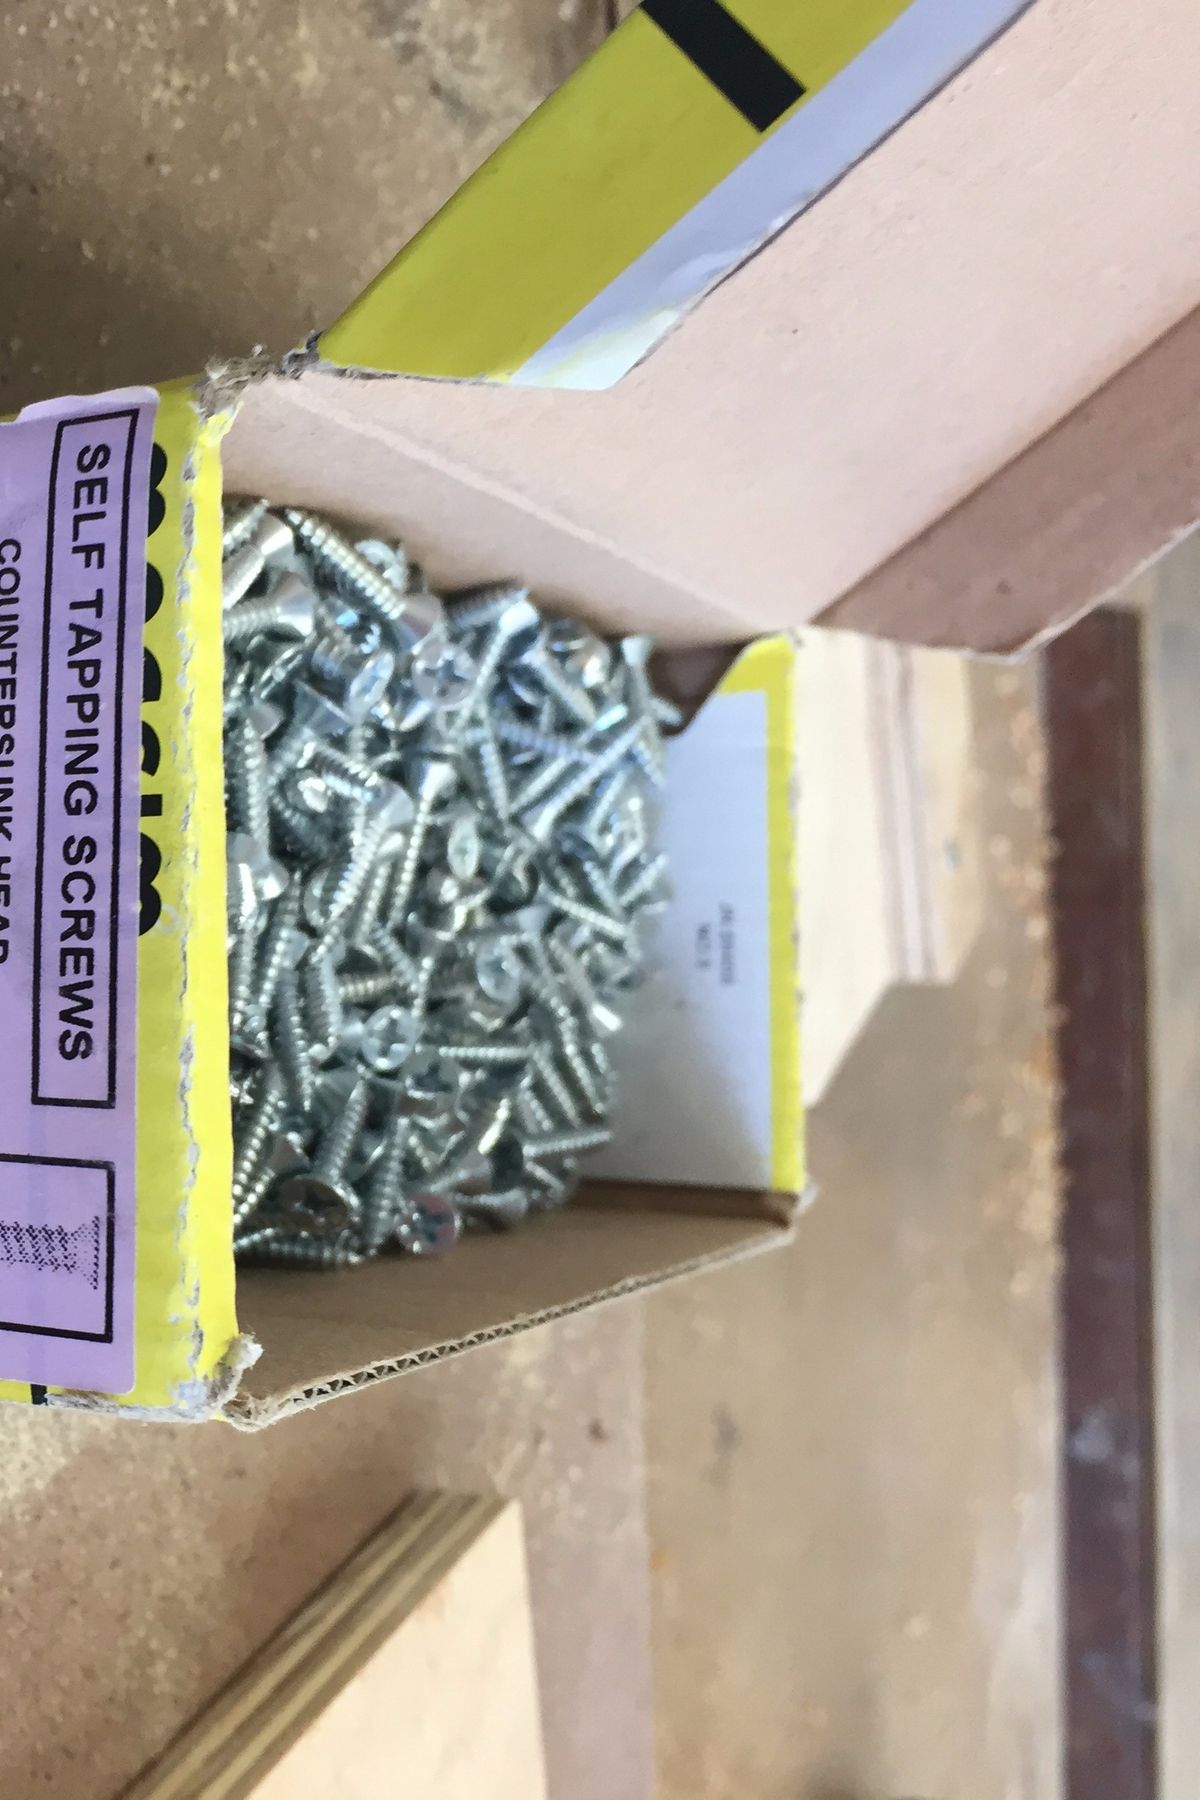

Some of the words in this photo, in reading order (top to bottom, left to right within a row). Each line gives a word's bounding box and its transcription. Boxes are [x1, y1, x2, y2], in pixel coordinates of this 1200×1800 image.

[70, 442, 111, 570] SELF
[62, 588, 104, 817] TAPPING
[58, 836, 97, 1062] SCREWS
